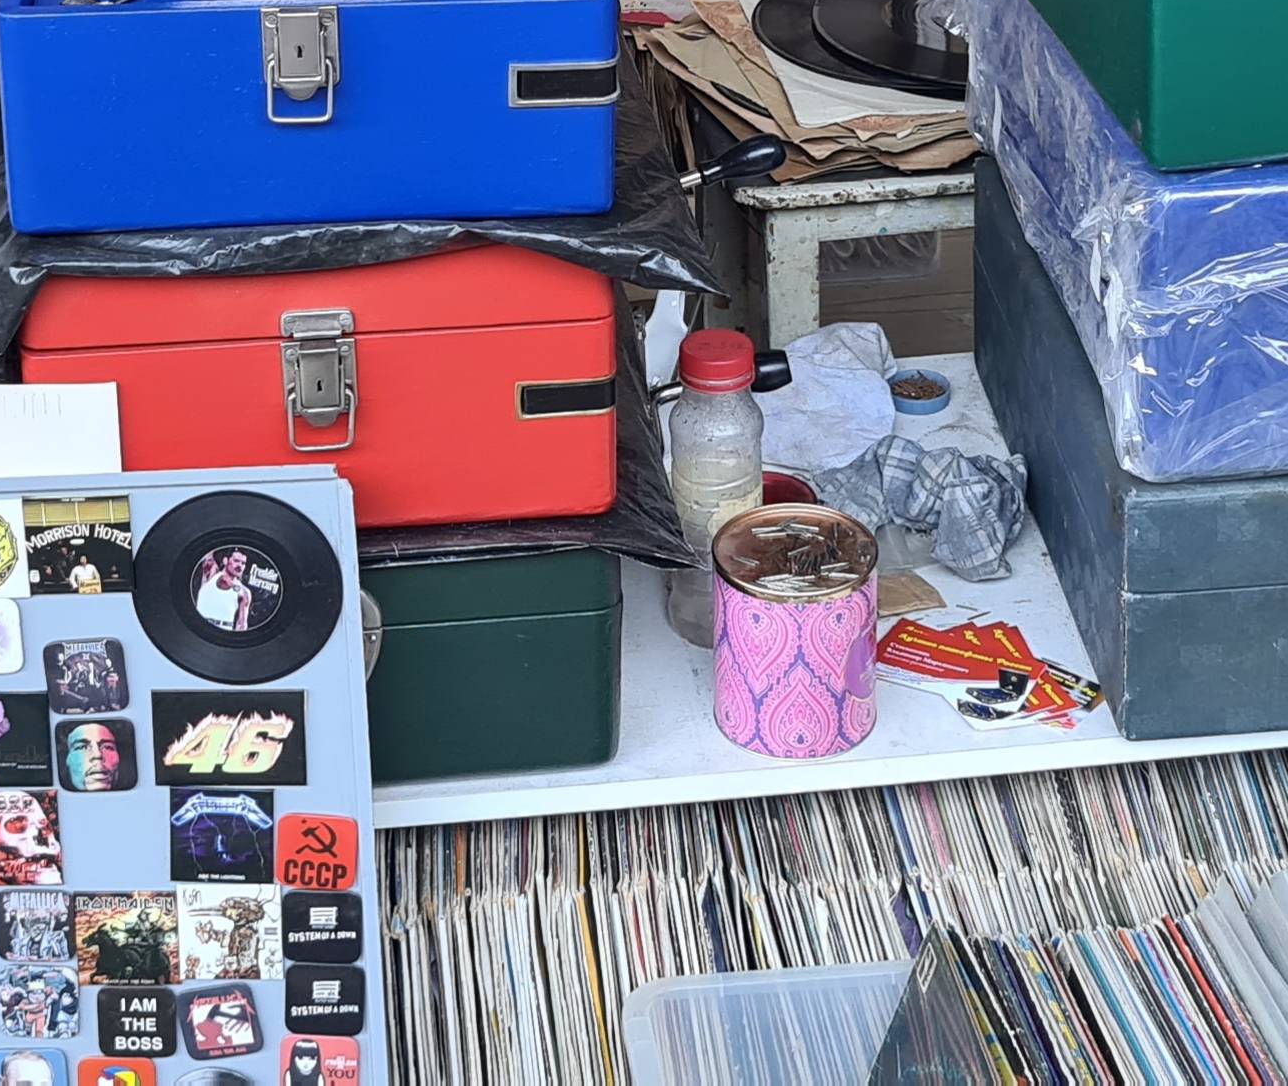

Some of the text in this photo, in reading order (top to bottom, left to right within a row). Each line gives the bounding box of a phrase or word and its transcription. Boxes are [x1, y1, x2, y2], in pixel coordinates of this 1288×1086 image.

[24, 523, 133, 553] MORRISON HOTEL
[163, 710, 295, 774] 46
[283, 858, 348, 888] СССР
[76, 896, 114, 911] IRON
[120, 997, 158, 1013] I AM
[120, 1016, 158, 1032] THE
[114, 1035, 164, 1051] BOSS
[327, 1068, 355, 1080] YOU
